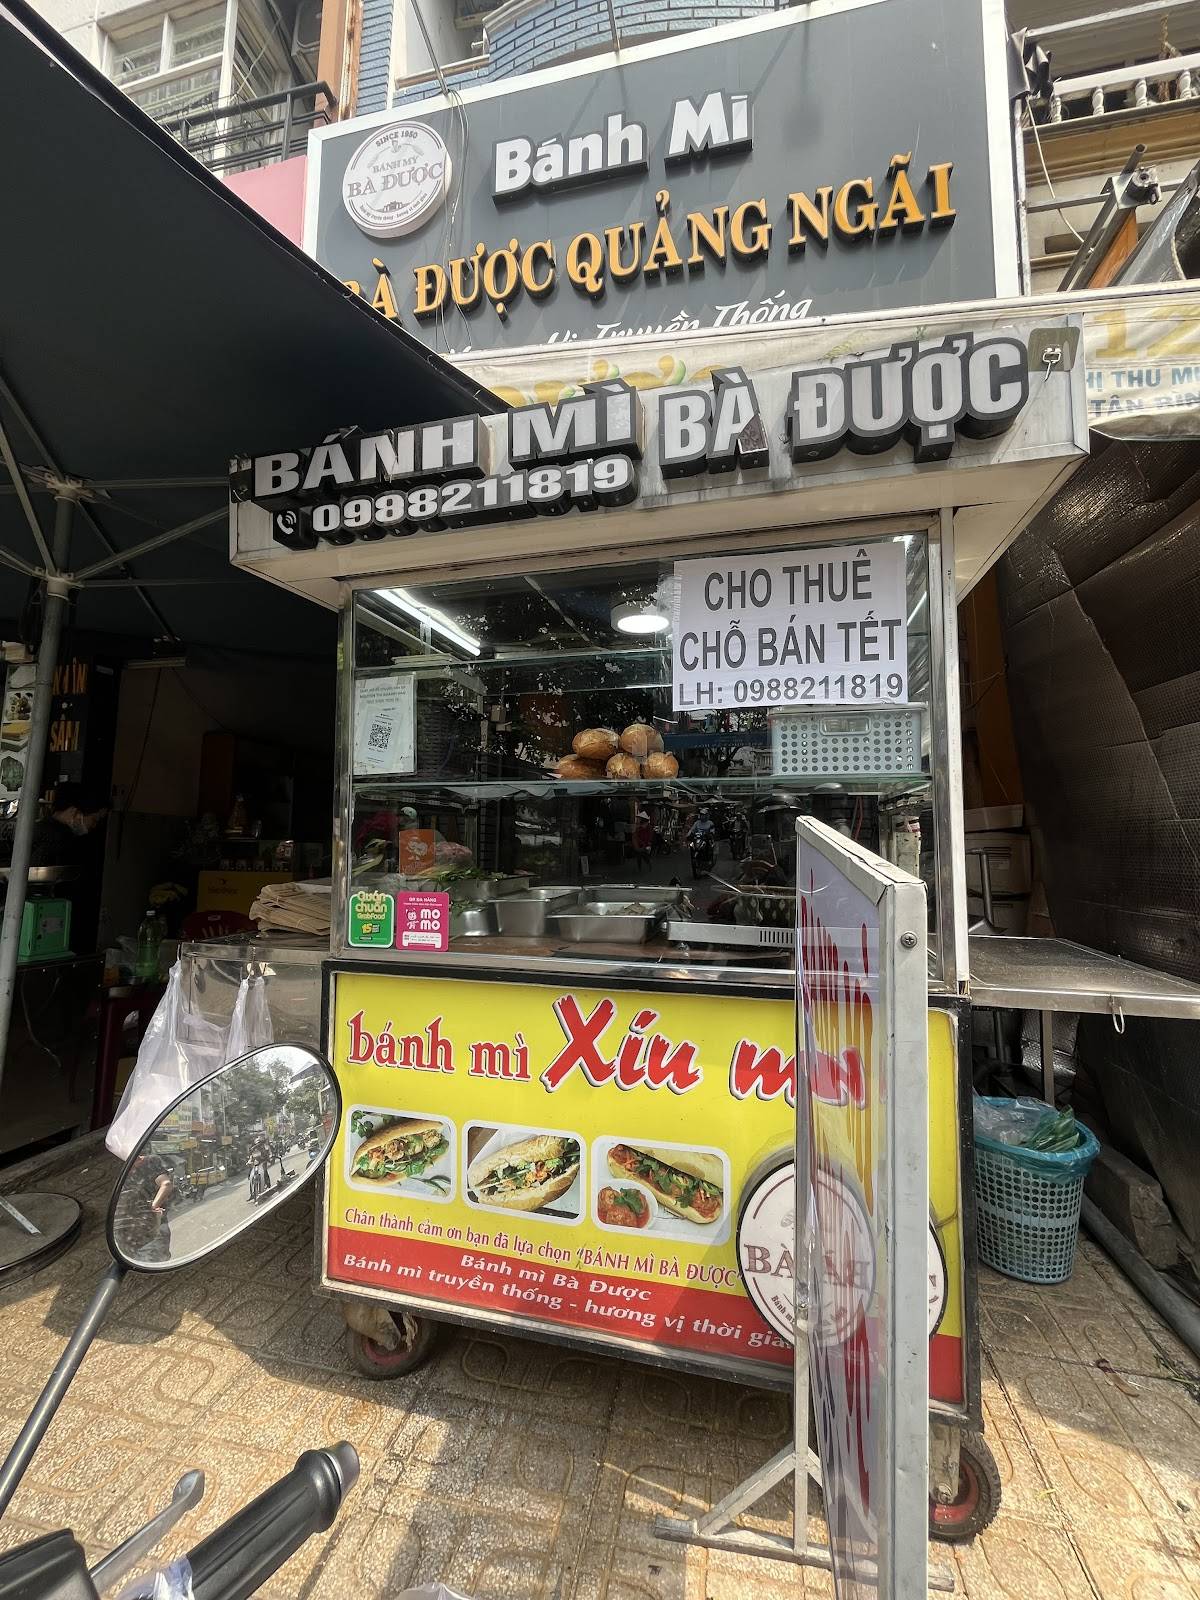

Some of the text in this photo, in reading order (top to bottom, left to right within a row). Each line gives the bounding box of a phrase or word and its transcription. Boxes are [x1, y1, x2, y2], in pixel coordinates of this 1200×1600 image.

[375, 130, 418, 147] SINCE 1950
[494, 112, 645, 195] Bánh
[347, 161, 444, 199] BÀ ĐƯỢC
[413, 237, 557, 316] ĐƯỢC
[566, 189, 774, 293] QUẢNG
[787, 151, 957, 245] NGÃI
[253, 424, 475, 499] BÁNH
[511, 382, 632, 459] MÌ
[663, 371, 769, 460] BÀ
[793, 340, 1023, 440] ĐƯỢC
[311, 455, 631, 533] 0988211819
[704, 548, 872, 611] CHO THUÊ
[679, 610, 902, 671] CHỖ BÁN TẾT
[679, 672, 903, 706] LH: 0988211819
[420, 908, 441, 919] mo
[420, 919, 441, 930] mo
[348, 1010, 455, 1073] bánh
[469, 1032, 531, 1082] mì
[539, 993, 704, 1095] Xíu
[344, 1207, 376, 1227] Chân
[379, 1212, 414, 1233] thành
[417, 1218, 444, 1238] cảm
[447, 1225, 463, 1241] ơn
[466, 1226, 490, 1248] bạn
[493, 1232, 509, 1249] đã
[513, 1235, 534, 1256] lựa
[538, 1240, 571, 1261] chọn
[633, 1252, 654, 1275] MÌ
[659, 1256, 680, 1278] BÀ
[343, 1253, 392, 1274] Bánh
[396, 1264, 423, 1279] mì
[428, 1268, 496, 1293] truyền
[502, 1282, 563, 1311] thống
[584, 1299, 657, 1328] hương
[664, 1315, 685, 1333] vị
[692, 1318, 743, 1340] thời
[460, 1254, 652, 1302] Bánh mì Bà Được
